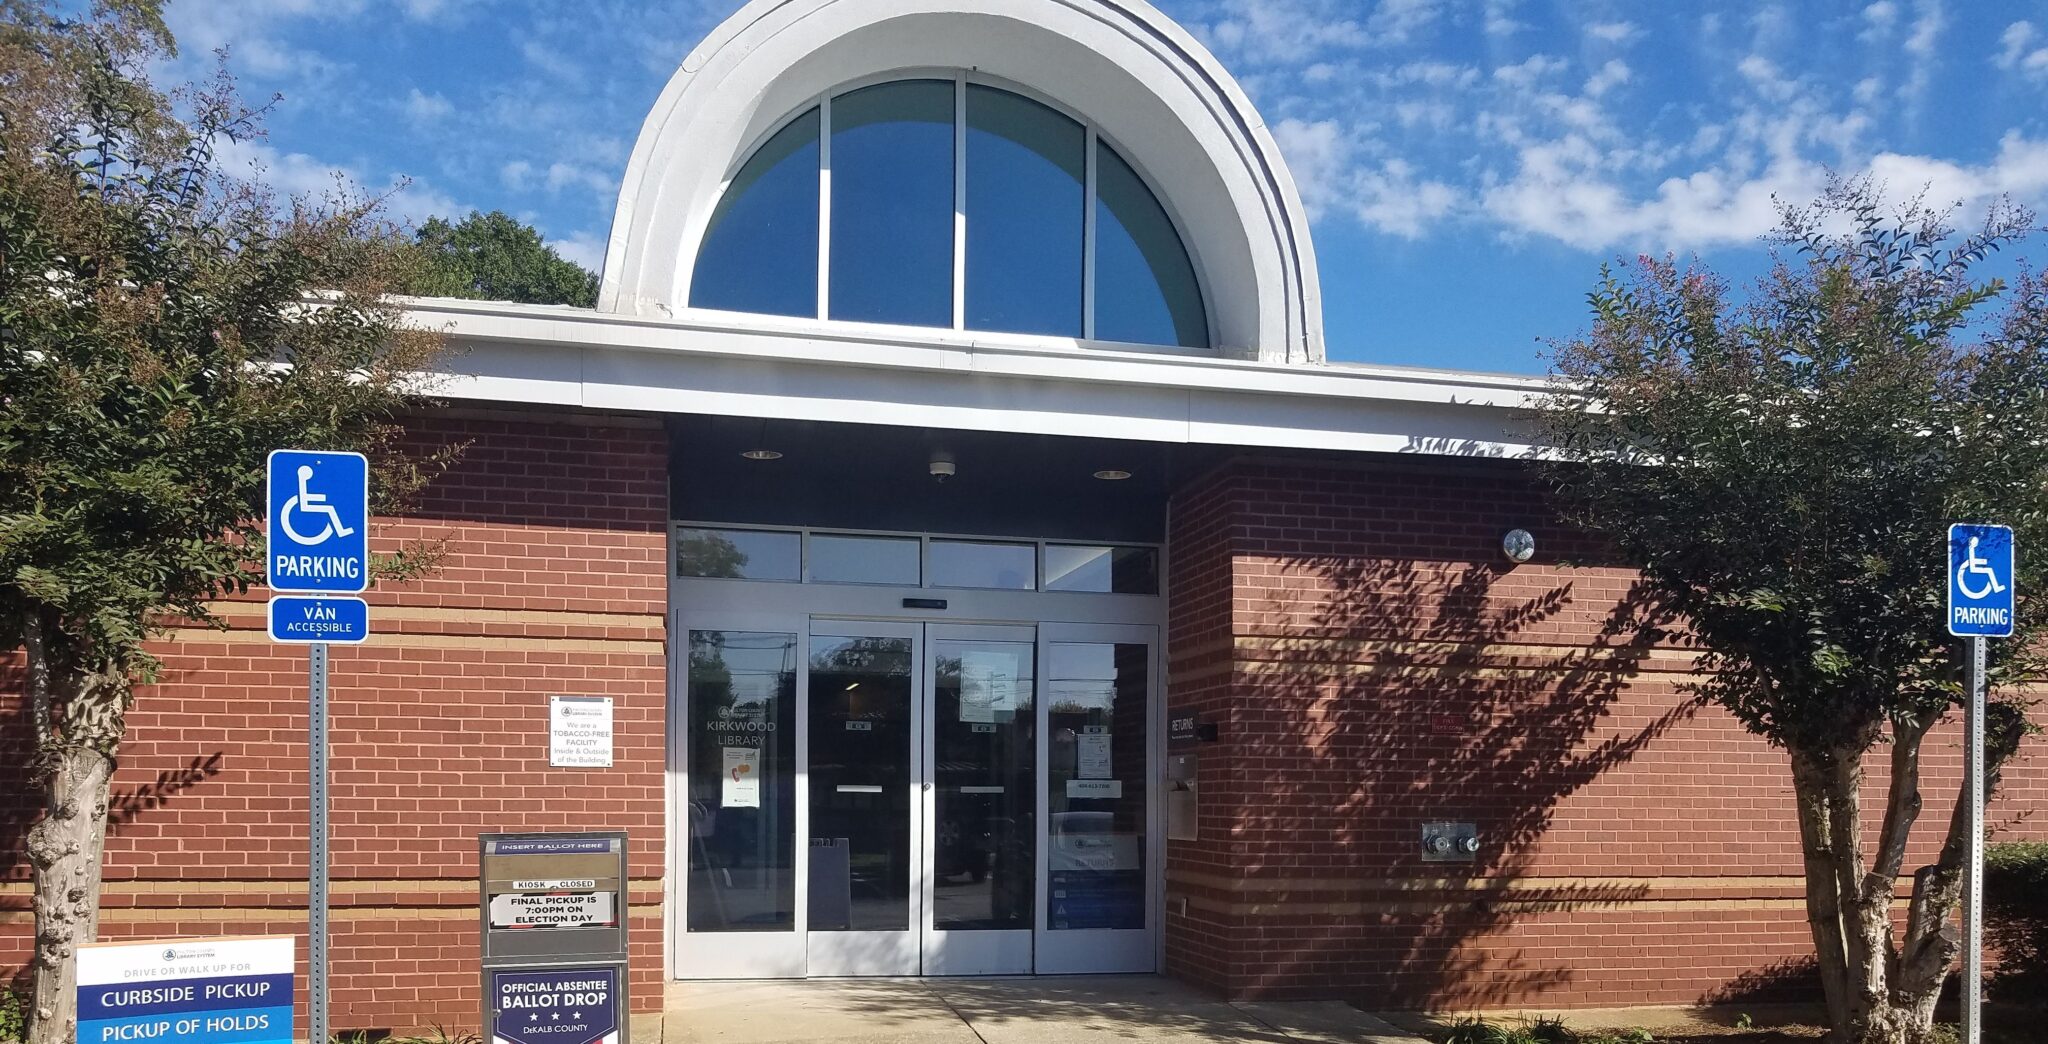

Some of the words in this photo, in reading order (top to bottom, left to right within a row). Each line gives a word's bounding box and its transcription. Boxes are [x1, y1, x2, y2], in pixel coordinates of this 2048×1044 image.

[276, 555, 359, 579] PARKING
[303, 607, 336, 620] VAN
[1954, 607, 2009, 625] PARKING
[286, 622, 353, 633] ACCESSIBLE
[706, 721, 776, 732] KIRKWOOD
[1171, 717, 1194, 732] RETURNS
[553, 730, 610, 738] TOBACCO-FREE
[718, 735, 766, 745] LIBRARY
[583, 748, 610, 756] Outside
[578, 756, 606, 765] Building
[518, 881, 546, 889] KIOSK
[511, 898, 544, 906] FINAL
[545, 897, 585, 905] PICKUP
[587, 896, 597, 904] IS
[515, 916, 568, 924] ELECTION
[124, 968, 157, 978] DRIVE
[160, 967, 175, 975] OR
[179, 965, 209, 974] WALK
[213, 964, 227, 972] UP
[230, 963, 251, 971] FOR
[501, 982, 553, 993] OFFICIAL
[555, 980, 608, 991] ABSENTEE
[101, 986, 194, 1007] CURBSIDE
[205, 982, 271, 999] PICKUP
[502, 993, 560, 1009] BALLOT
[564, 992, 608, 1006] DROP
[102, 1021, 170, 1042] PICKUP
[175, 1018, 200, 1035] OF
[207, 1014, 269, 1032] HOLDS
[554, 1024, 588, 1033] COUNTY
